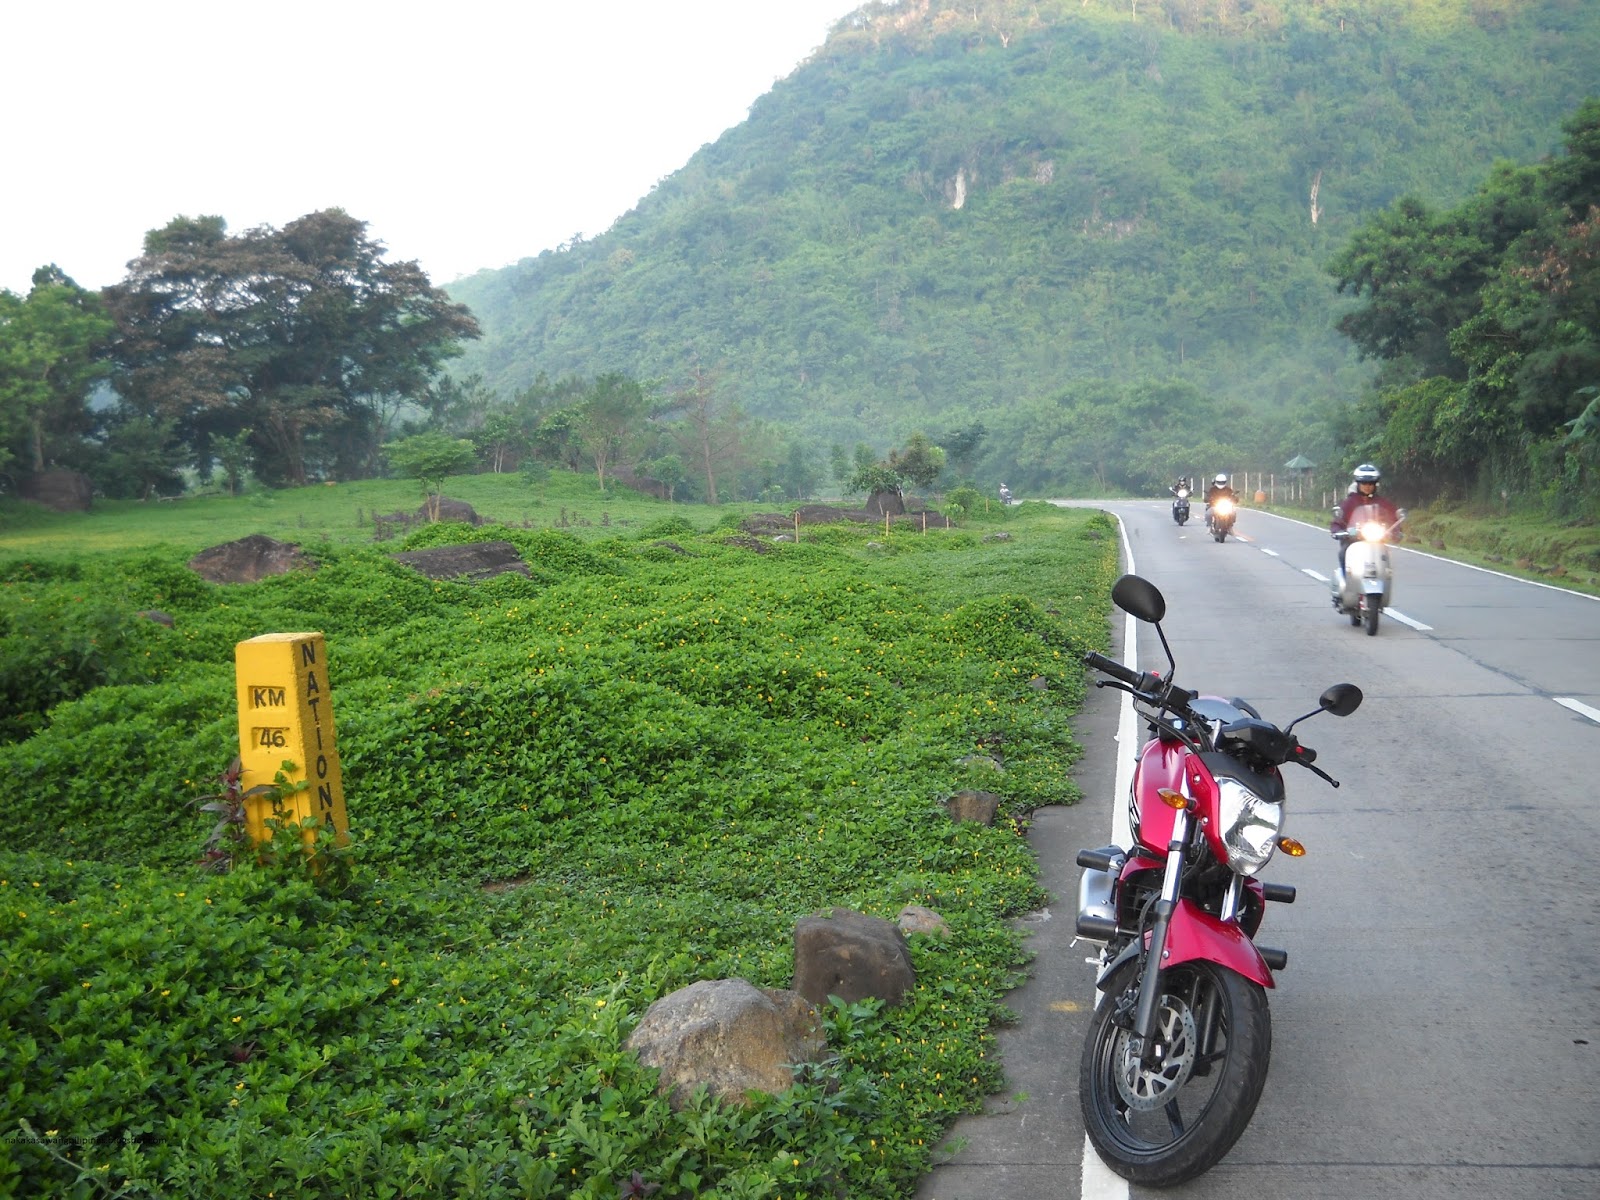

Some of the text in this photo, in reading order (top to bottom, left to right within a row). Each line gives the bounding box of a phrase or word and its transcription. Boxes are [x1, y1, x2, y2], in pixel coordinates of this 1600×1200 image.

[253, 688, 286, 708] KM
[259, 728, 287, 748] 46
[301, 642, 336, 835] NATIONA
